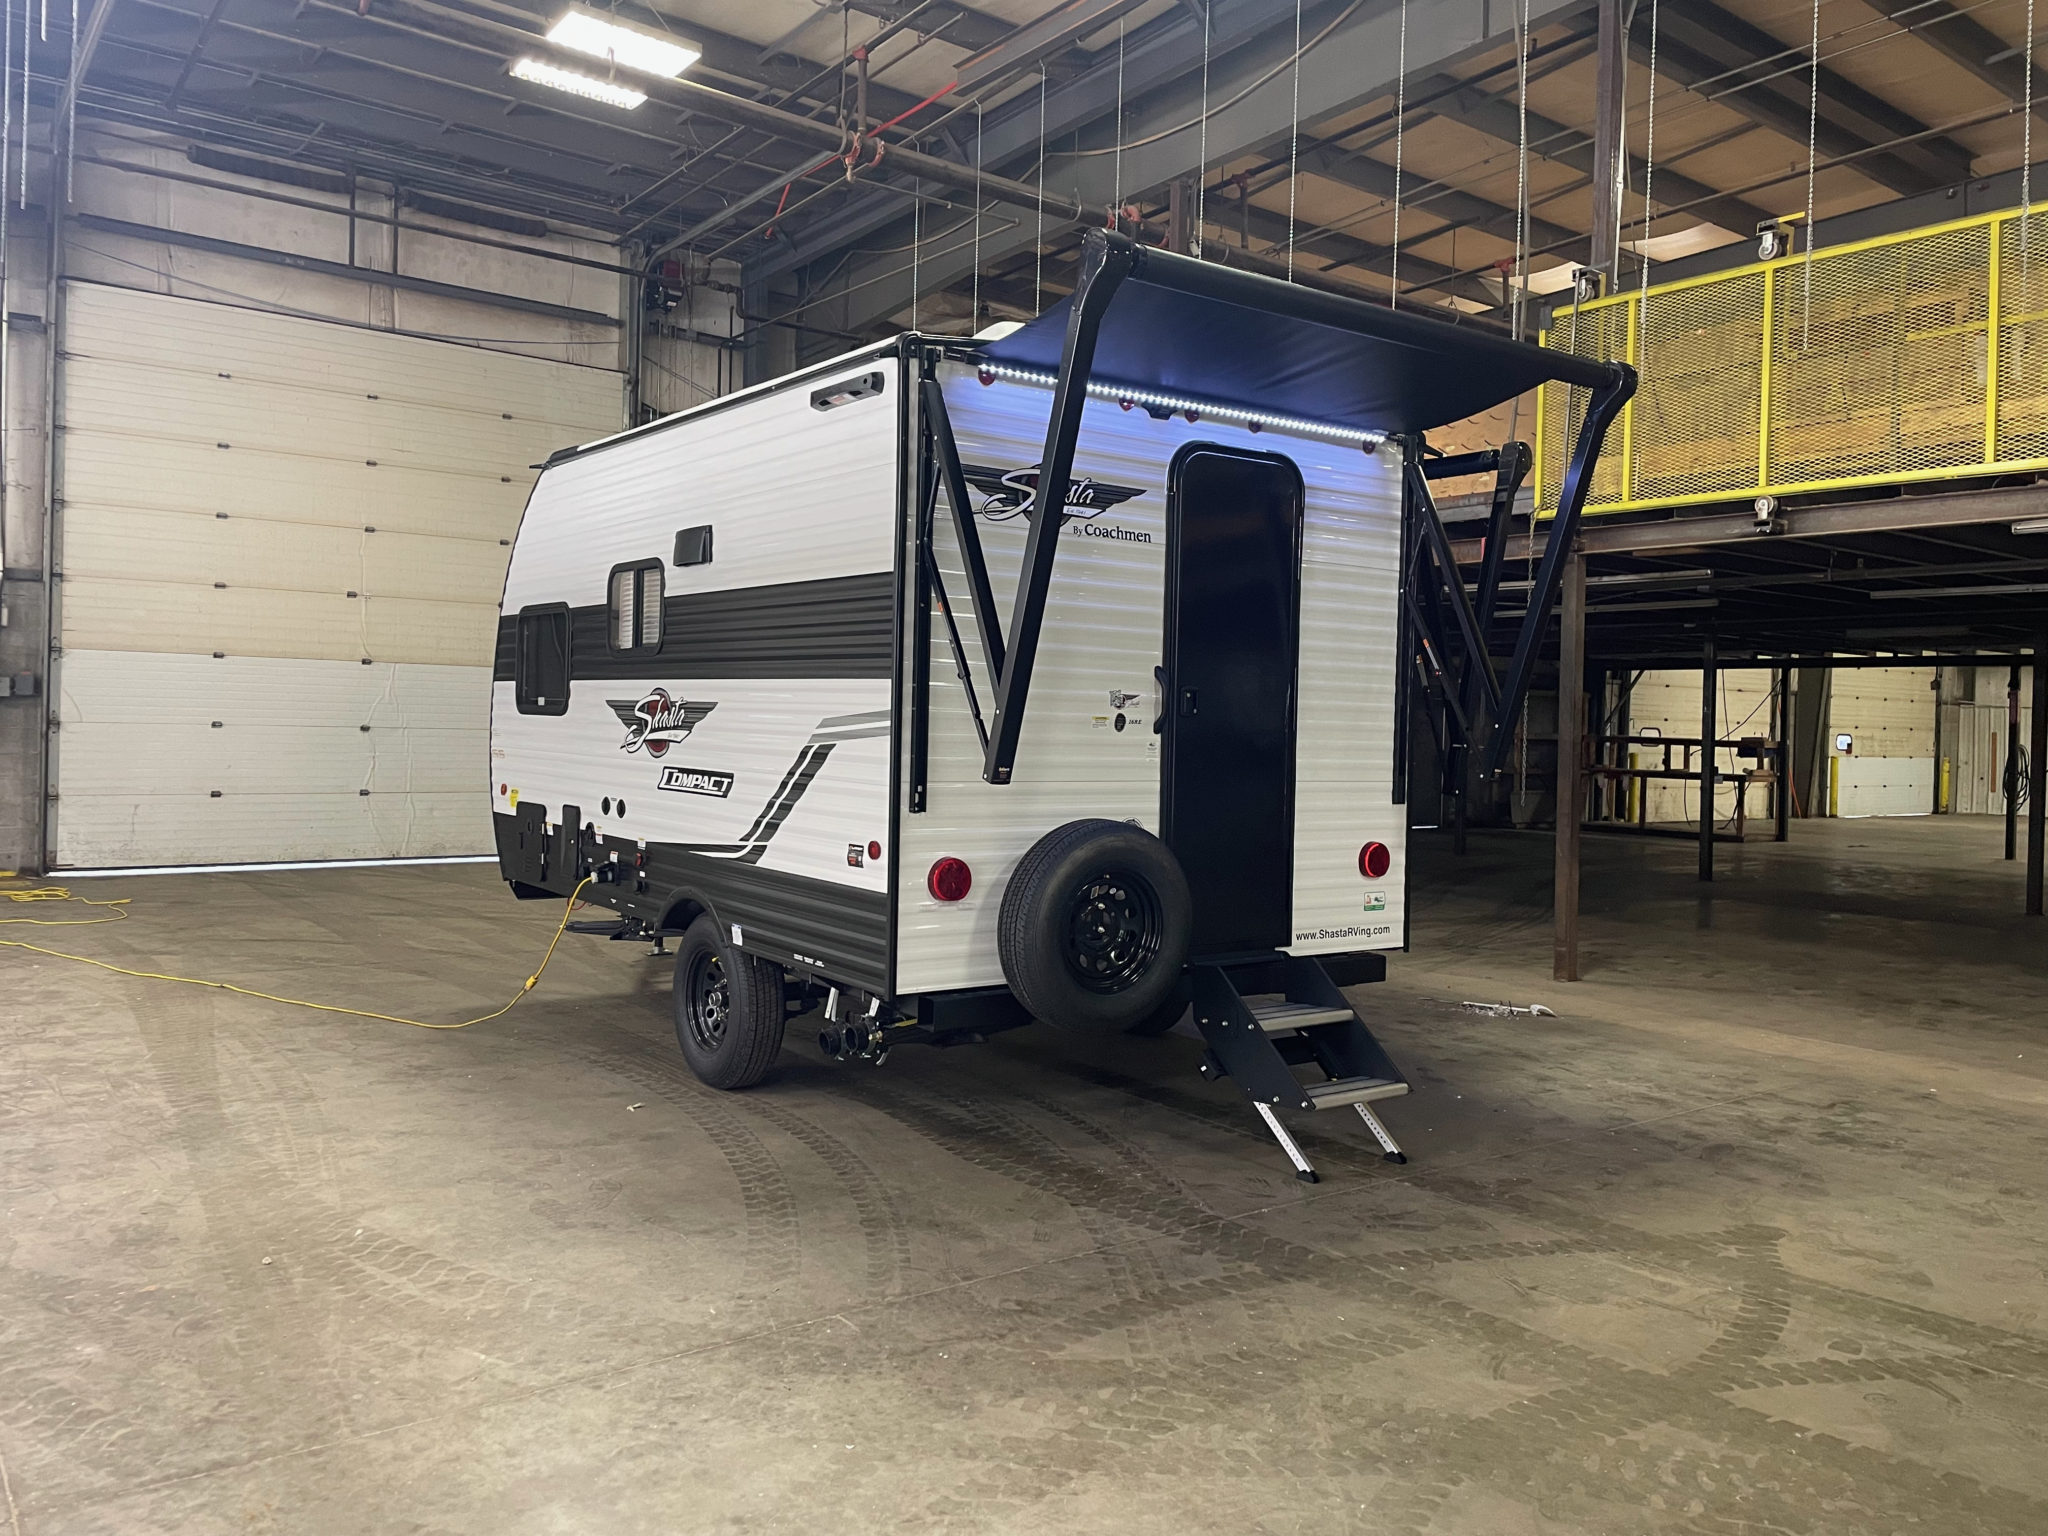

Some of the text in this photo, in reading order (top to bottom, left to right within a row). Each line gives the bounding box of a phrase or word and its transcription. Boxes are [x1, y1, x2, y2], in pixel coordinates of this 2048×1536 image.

[981, 467, 1099, 521] Ssta
[1073, 524, 1152, 543] By Coachmen
[625, 694, 688, 754] Shasta
[658, 768, 732, 796] COMPACT
[1295, 925, 1391, 941] www.ShastaRVing.com
